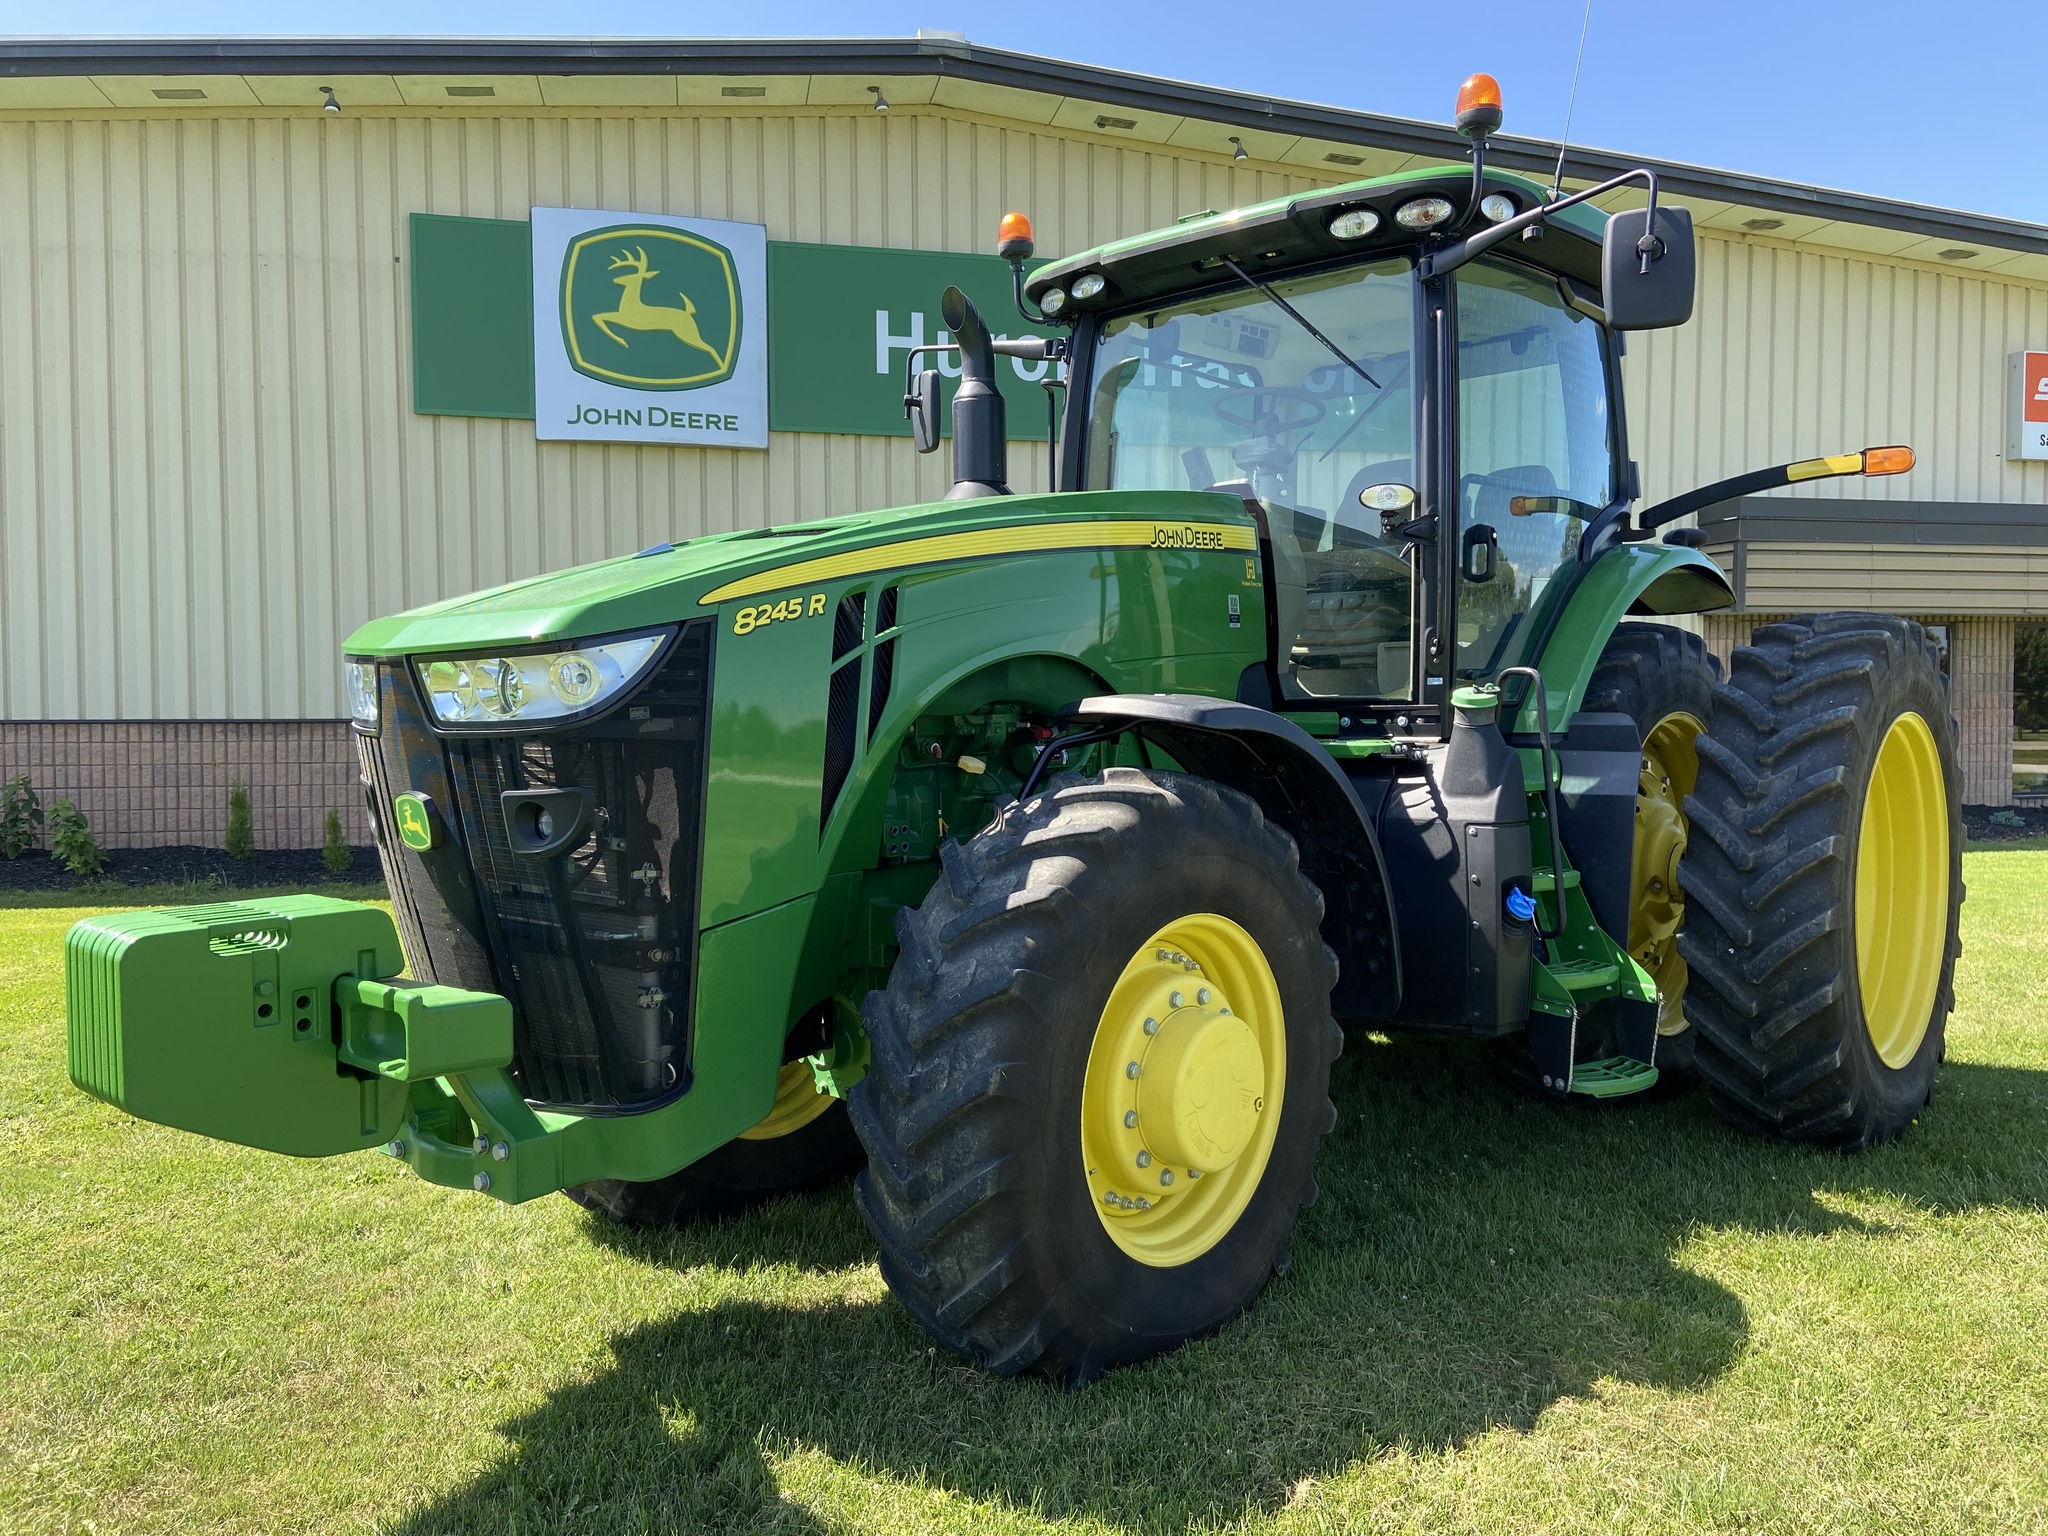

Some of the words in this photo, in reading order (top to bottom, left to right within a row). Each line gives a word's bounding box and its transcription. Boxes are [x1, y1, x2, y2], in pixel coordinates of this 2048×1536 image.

[566, 404, 642, 427] JOHN
[648, 406, 739, 432] DEERE
[1150, 525, 1184, 547] JOHN
[1184, 526, 1224, 548] DEERE
[733, 597, 804, 636] 8245
[807, 593, 827, 618] R
